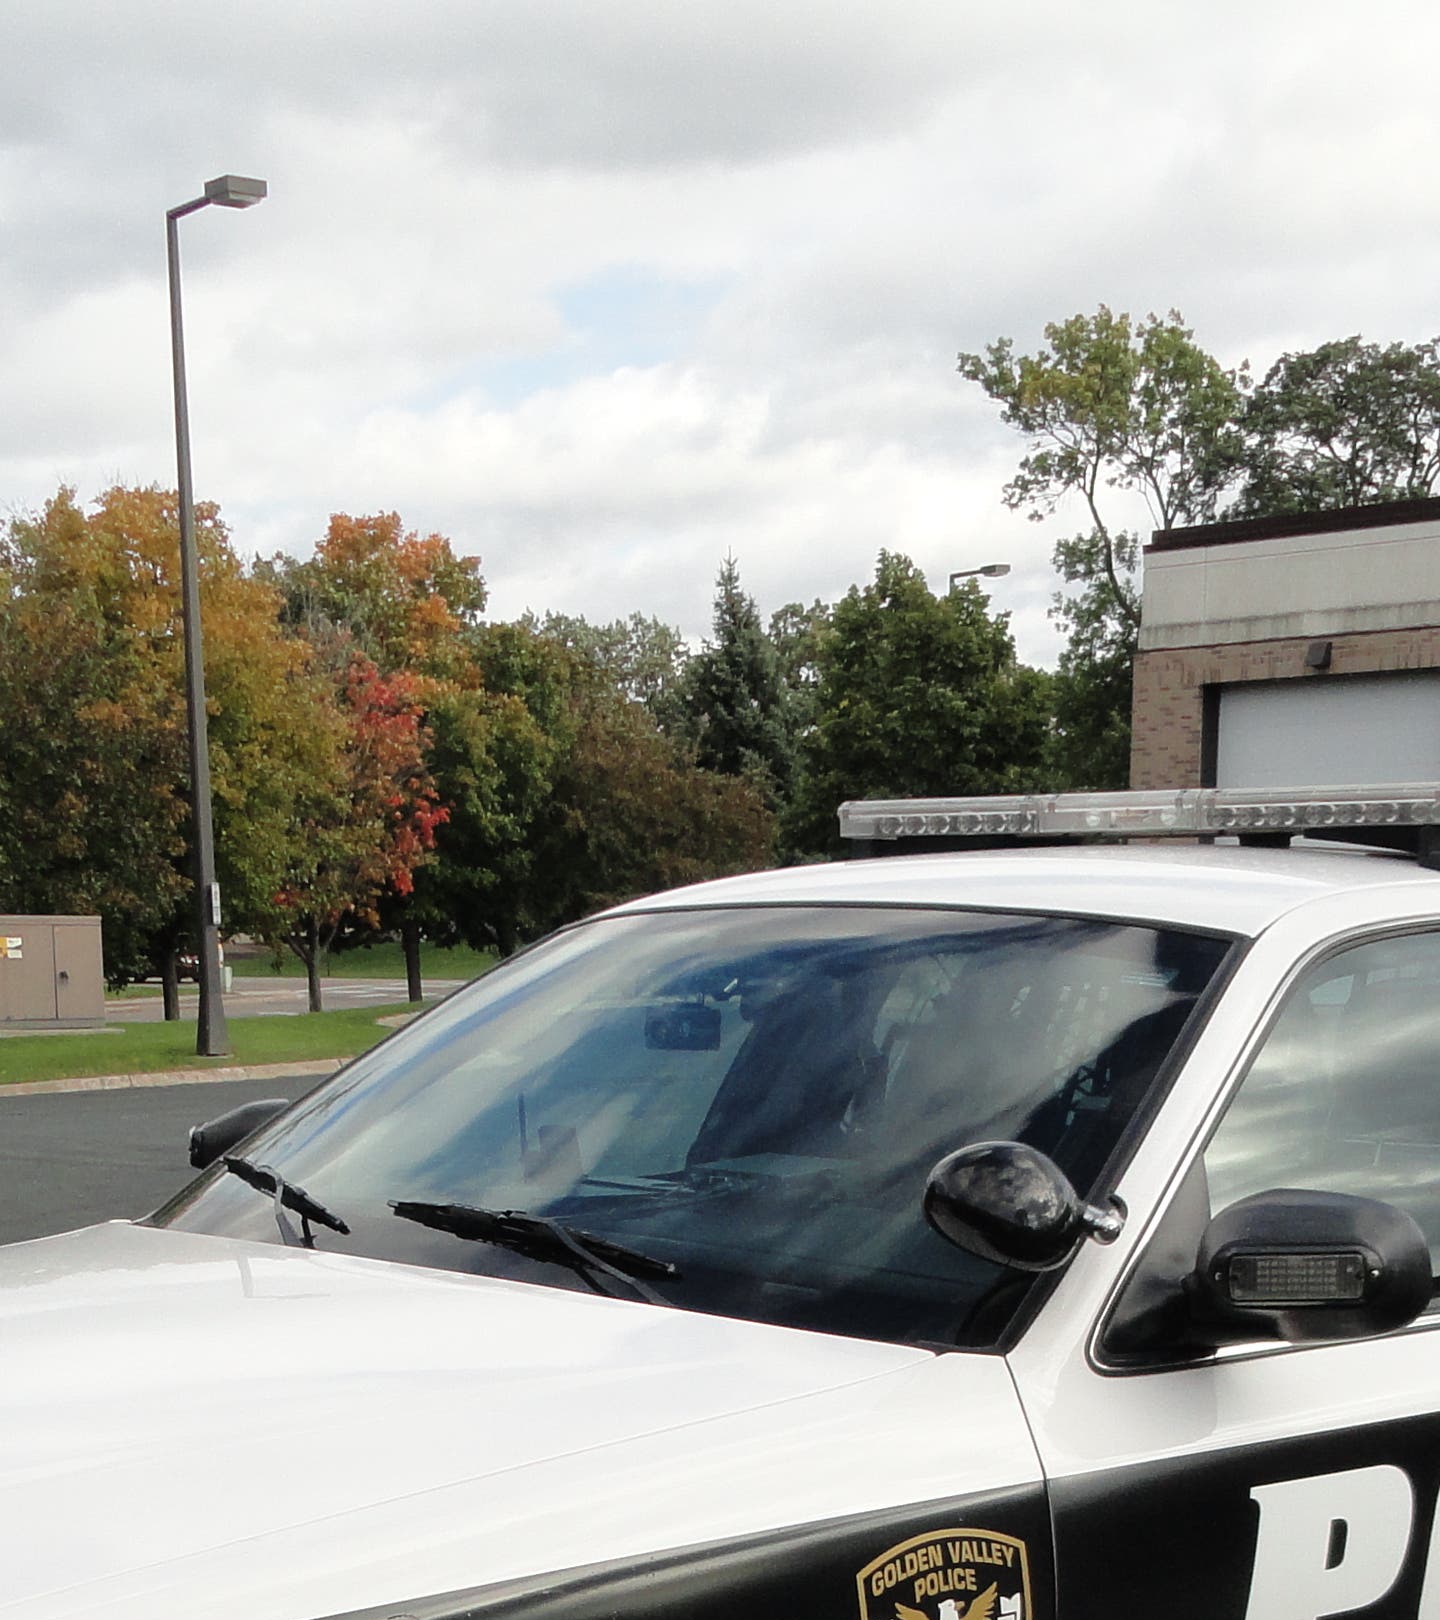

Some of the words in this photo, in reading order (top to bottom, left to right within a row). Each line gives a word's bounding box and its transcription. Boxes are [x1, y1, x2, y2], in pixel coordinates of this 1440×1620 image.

[871, 1544, 943, 1597] GOLDEN
[948, 1540, 1014, 1568] VALLEY
[914, 1567, 978, 1603] POLICE
